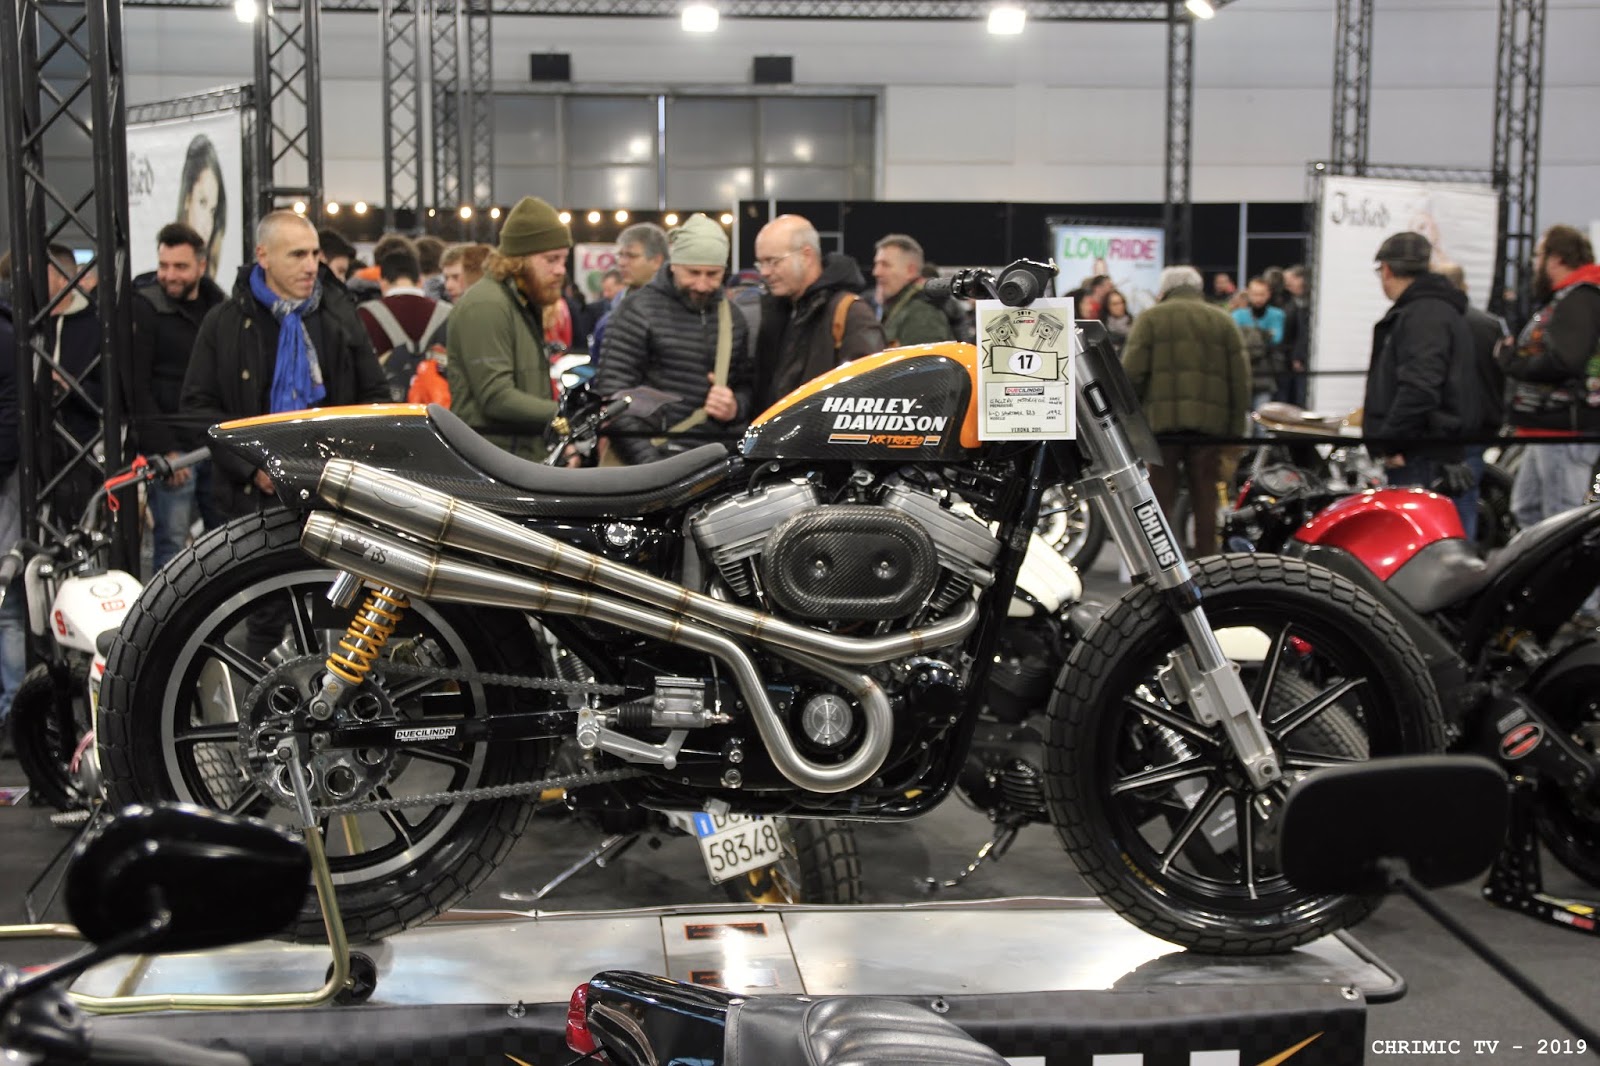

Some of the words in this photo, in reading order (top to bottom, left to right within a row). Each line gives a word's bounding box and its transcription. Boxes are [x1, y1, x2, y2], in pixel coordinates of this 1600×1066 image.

[1063, 236, 1156, 260] LOWRIDE
[1017, 354, 1034, 370] 17
[821, 396, 923, 414] HARLEY-
[832, 414, 948, 432] DAVIDSON
[396, 727, 455, 738] DUECILINDRI
[709, 824, 778, 871] 58348
